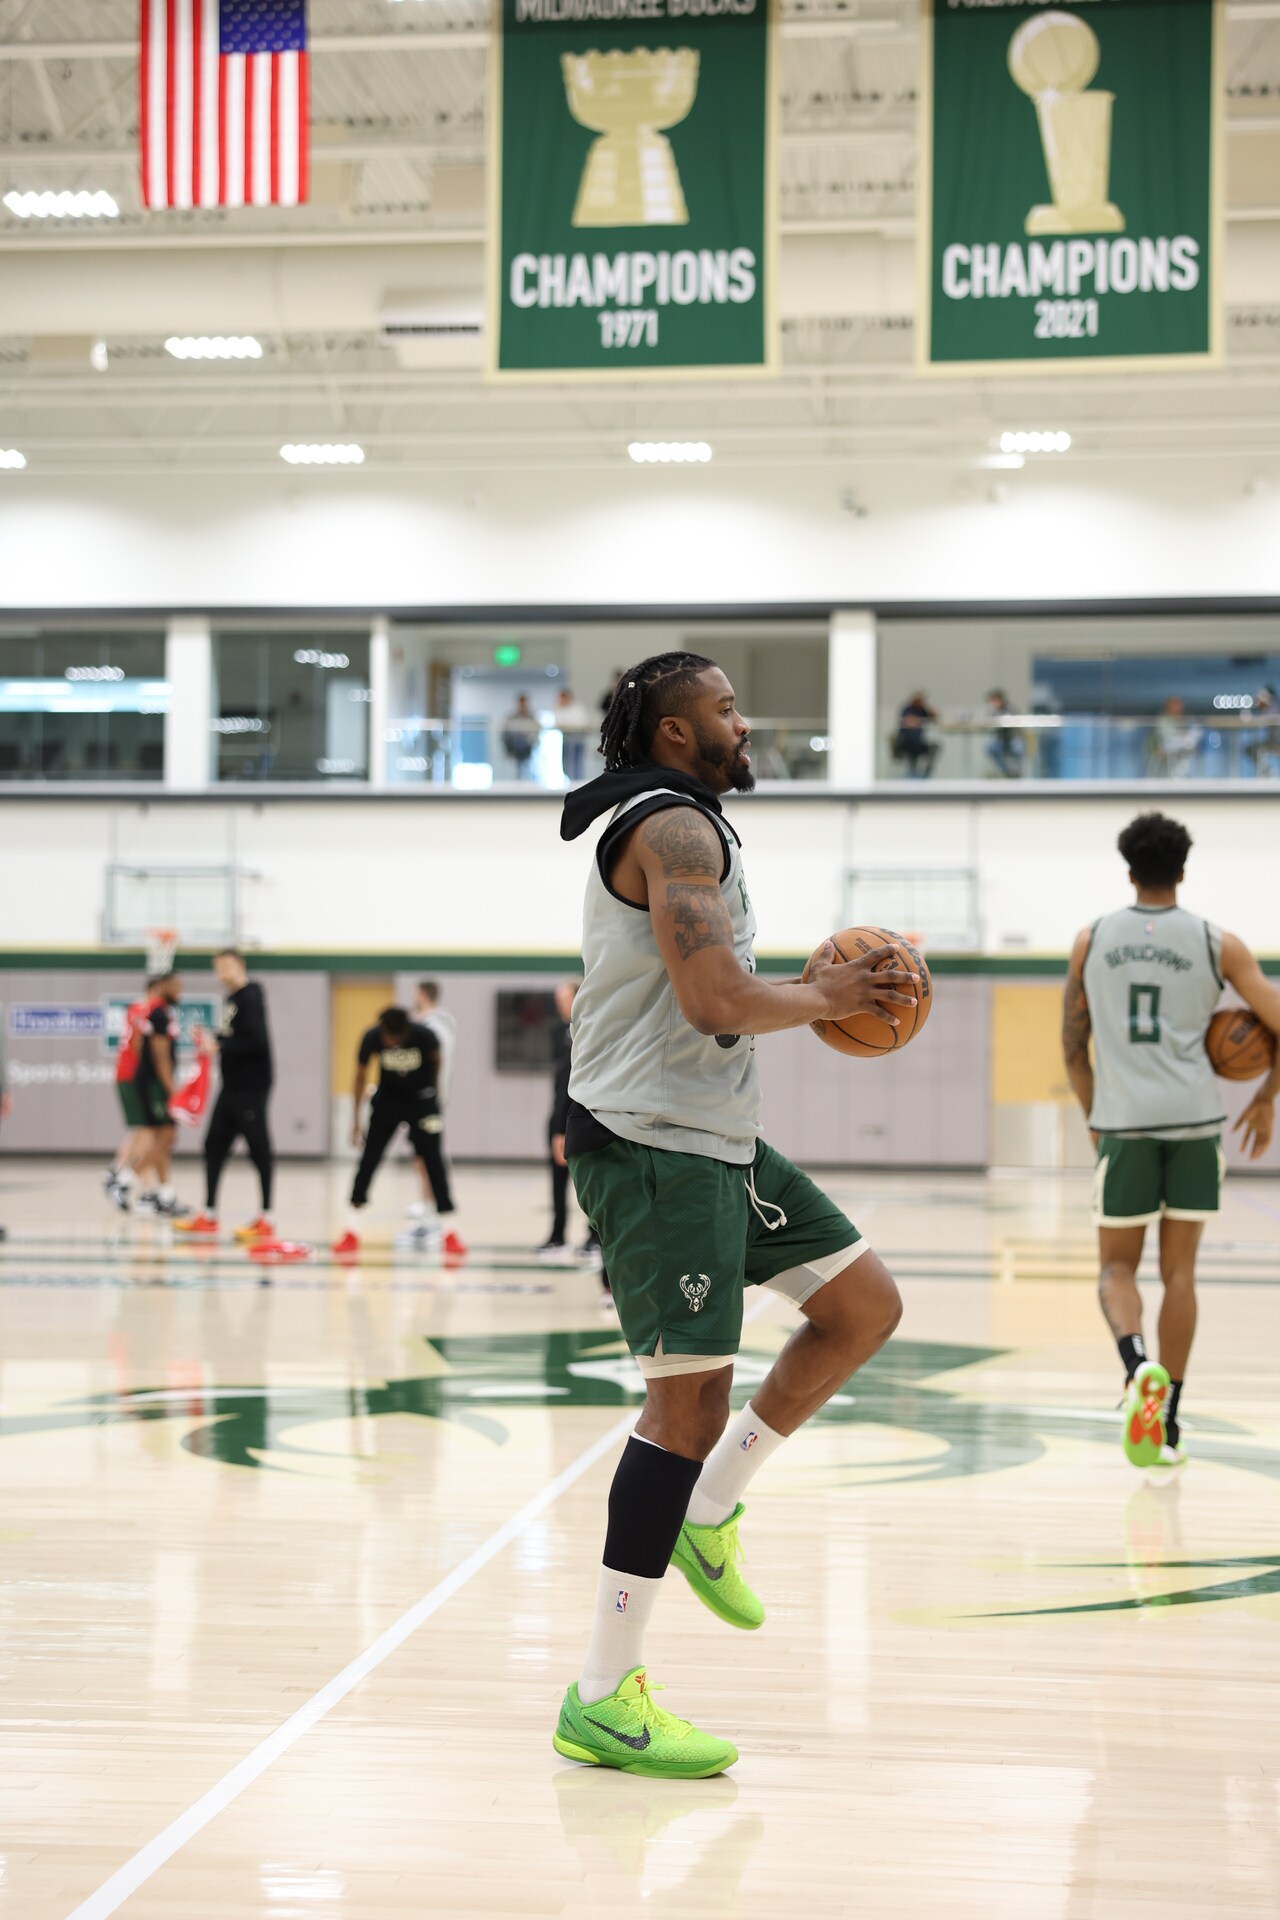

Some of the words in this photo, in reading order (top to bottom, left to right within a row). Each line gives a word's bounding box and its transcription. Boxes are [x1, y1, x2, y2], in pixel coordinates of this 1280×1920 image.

[509, 247, 756, 308] CHAMPIONS
[942, 234, 1200, 299] CHAMPIONS
[597, 309, 658, 348] 1971
[1033, 298, 1099, 339] 2021
[1129, 983, 1162, 1044] 0
